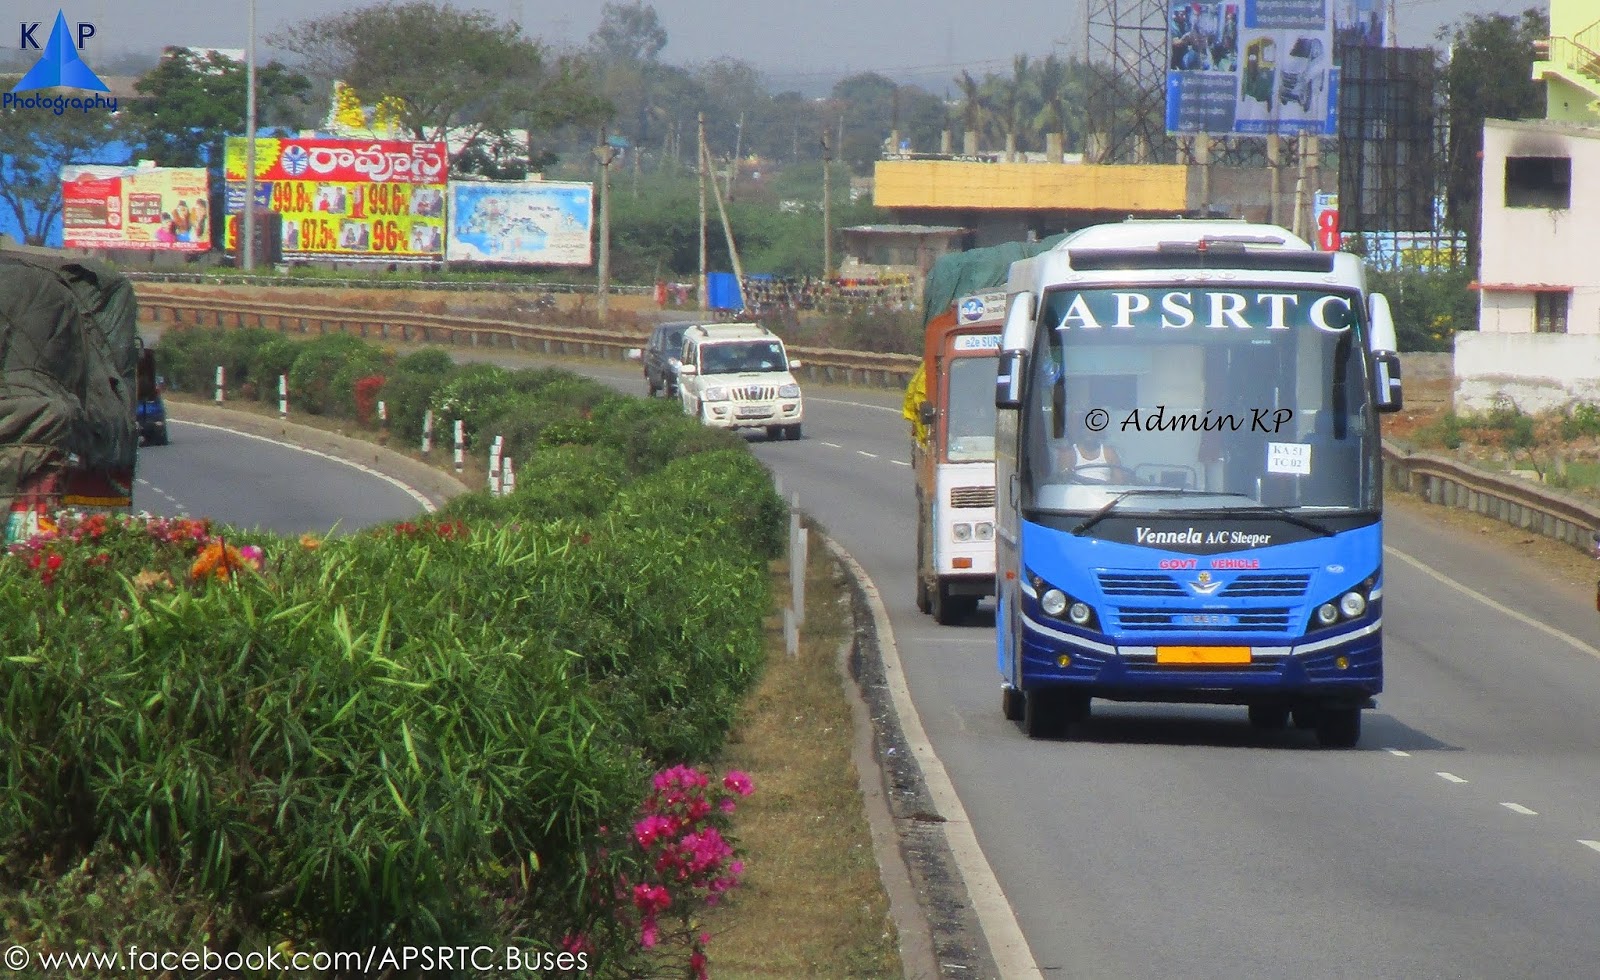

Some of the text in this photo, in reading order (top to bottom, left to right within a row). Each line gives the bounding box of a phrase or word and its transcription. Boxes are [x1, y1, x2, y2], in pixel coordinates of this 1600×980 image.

[1055, 291, 1352, 334] APSRTC
[1136, 527, 1271, 547] Vennela A/C Sleeper
[1159, 559, 1259, 569] GOVT VEHICLE
